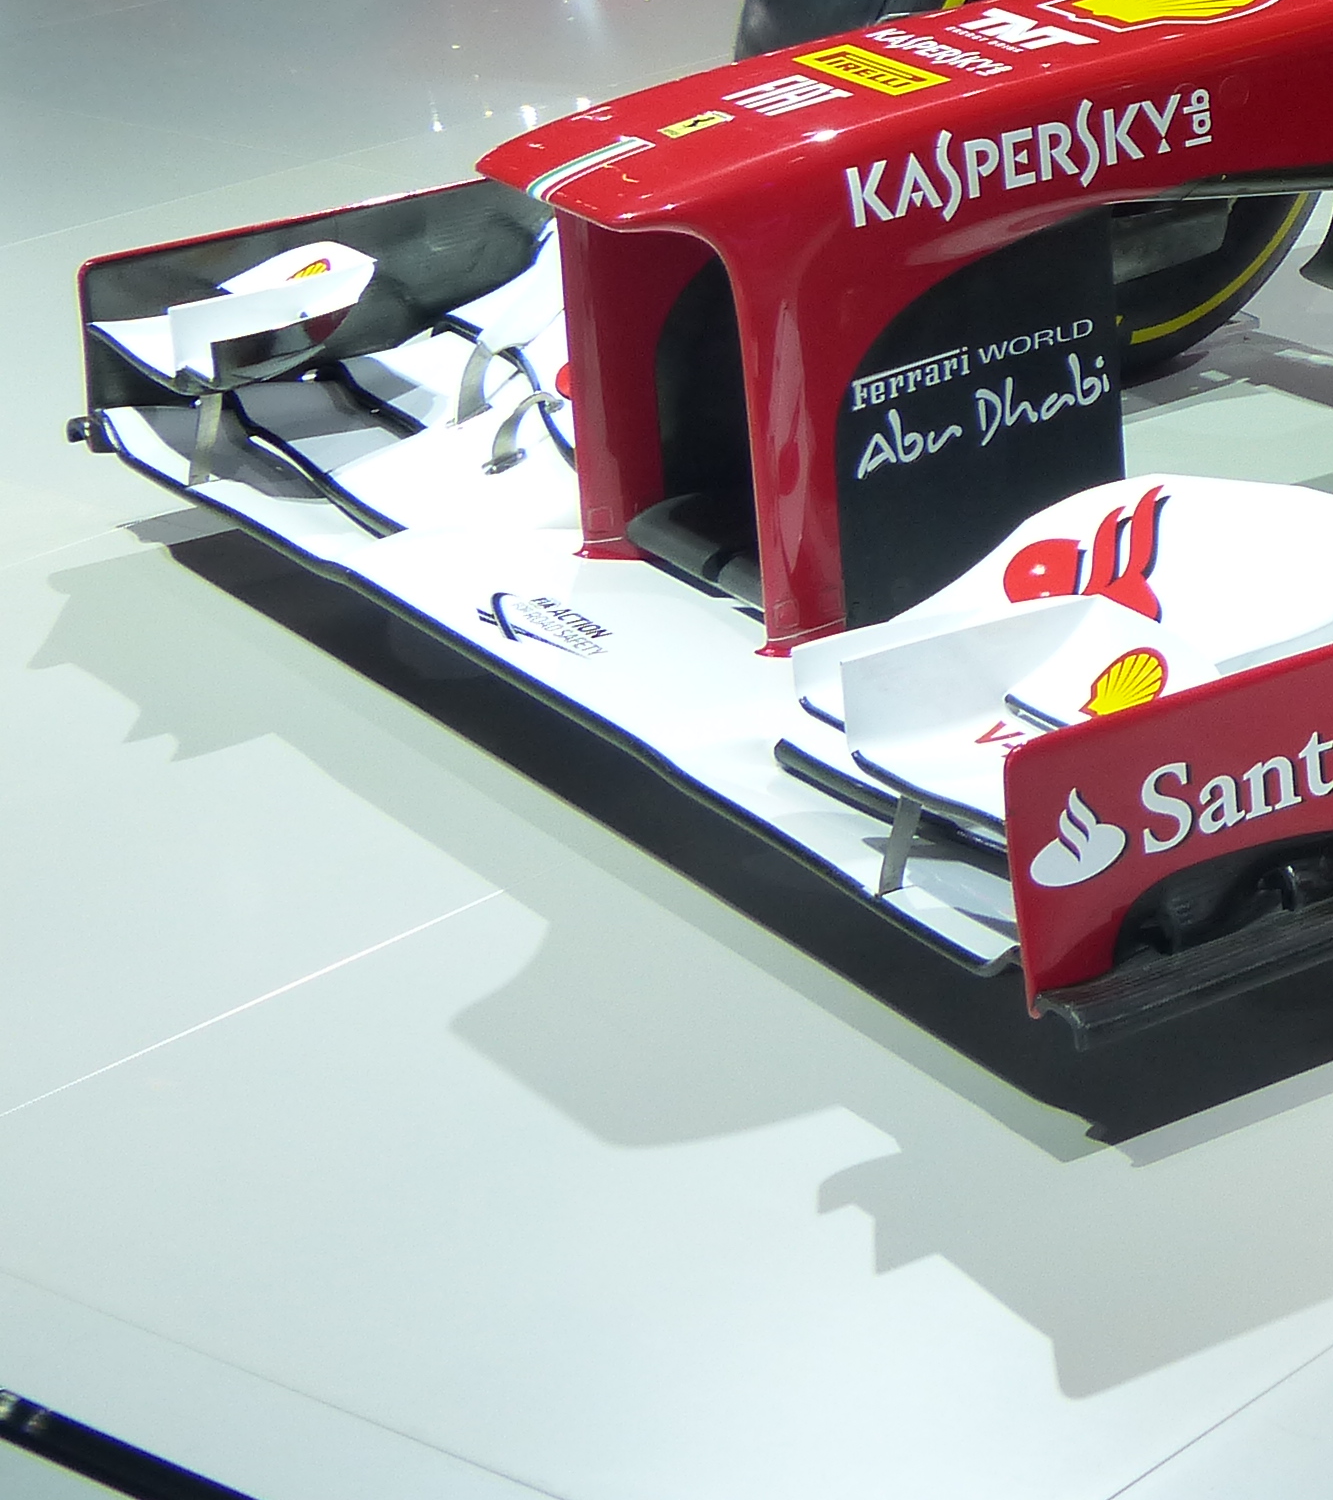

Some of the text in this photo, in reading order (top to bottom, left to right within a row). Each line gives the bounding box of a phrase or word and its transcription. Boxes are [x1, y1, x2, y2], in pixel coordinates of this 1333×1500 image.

[866, 27, 1004, 73] KASPERSKY
[958, 7, 1100, 50] TNT
[815, 51, 920, 90] PIRELLI
[846, 94, 1182, 228] KASPERSKY
[851, 318, 1094, 412] Ferrari WORLD
[855, 353, 1110, 479] Abu Dhabi
[546, 609, 613, 639] ACTION
[553, 629, 608, 656] SAFETY
